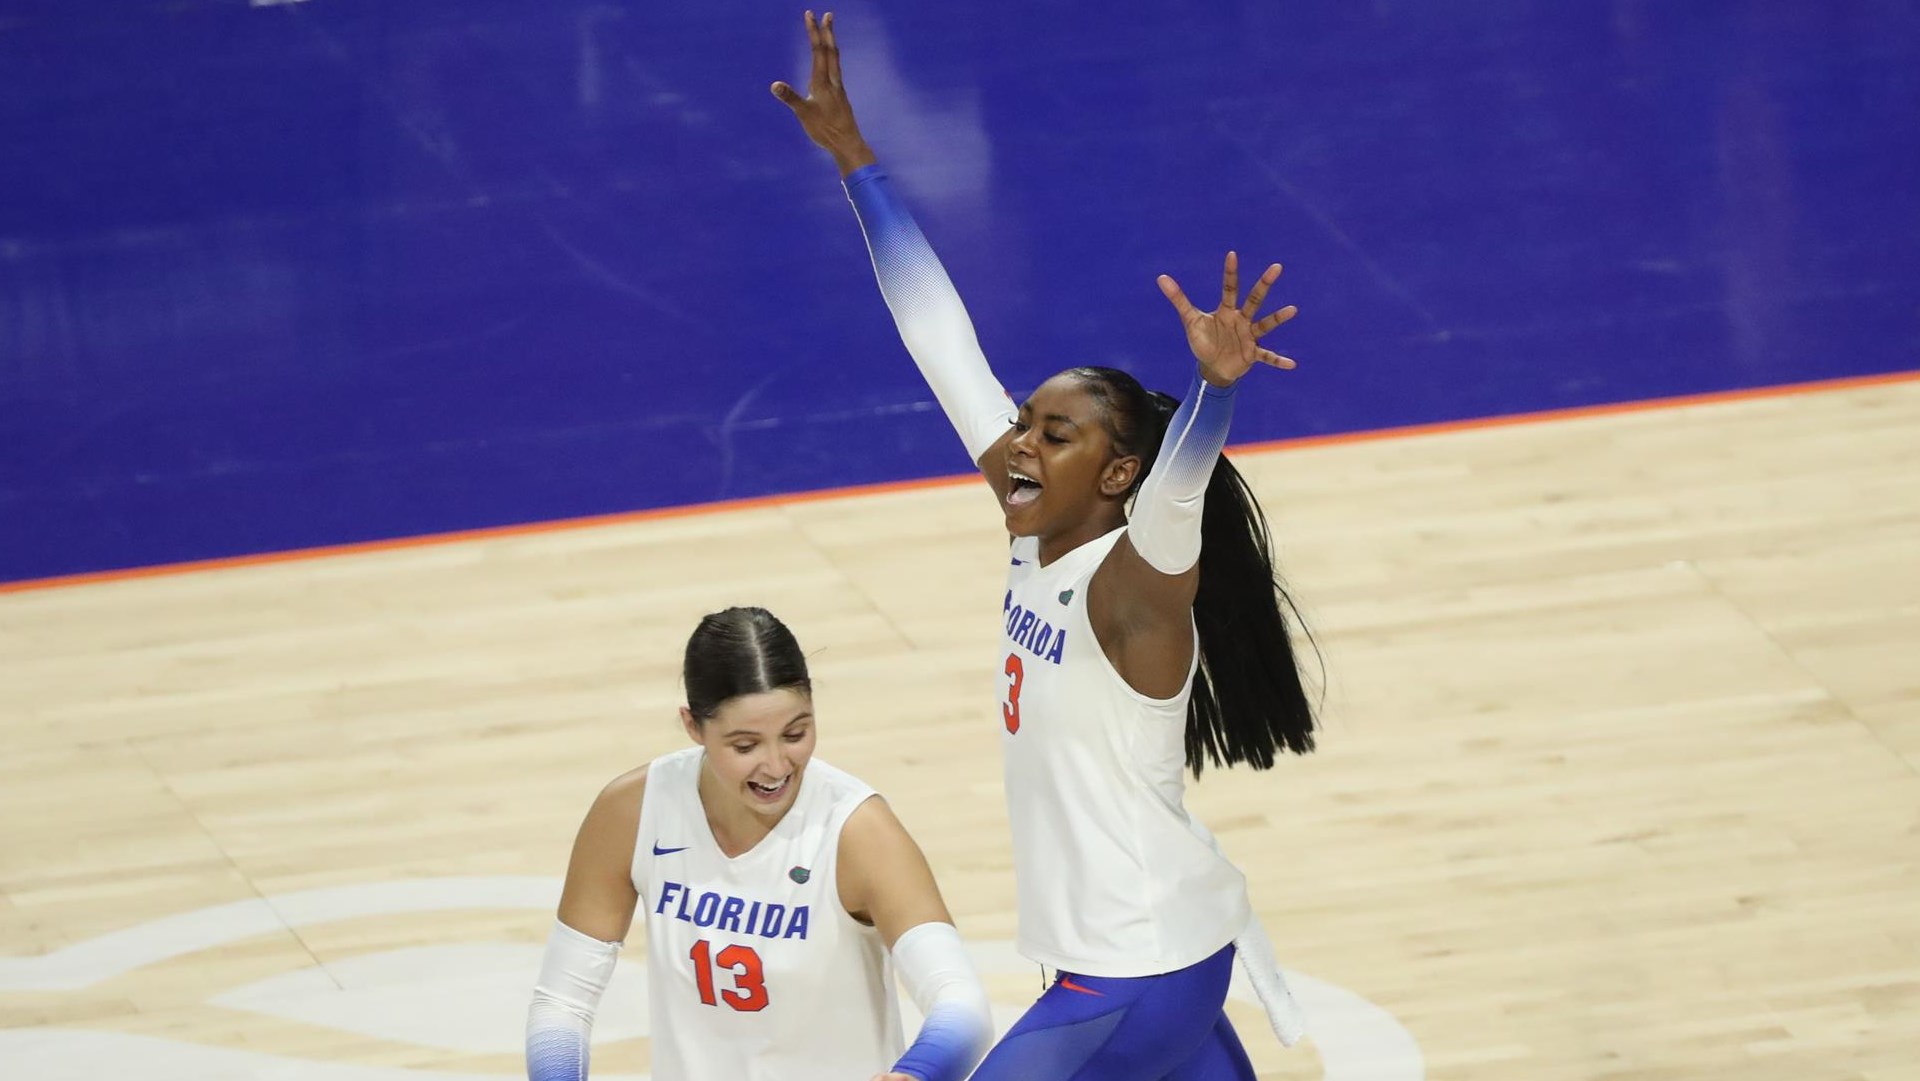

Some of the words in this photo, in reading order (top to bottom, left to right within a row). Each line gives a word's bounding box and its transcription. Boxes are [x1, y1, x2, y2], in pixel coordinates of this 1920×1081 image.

[1003, 589, 1066, 665] ORIDA
[1003, 653, 1024, 735] 3
[656, 881, 809, 940] FLORIDA
[690, 939, 769, 1012] 13
